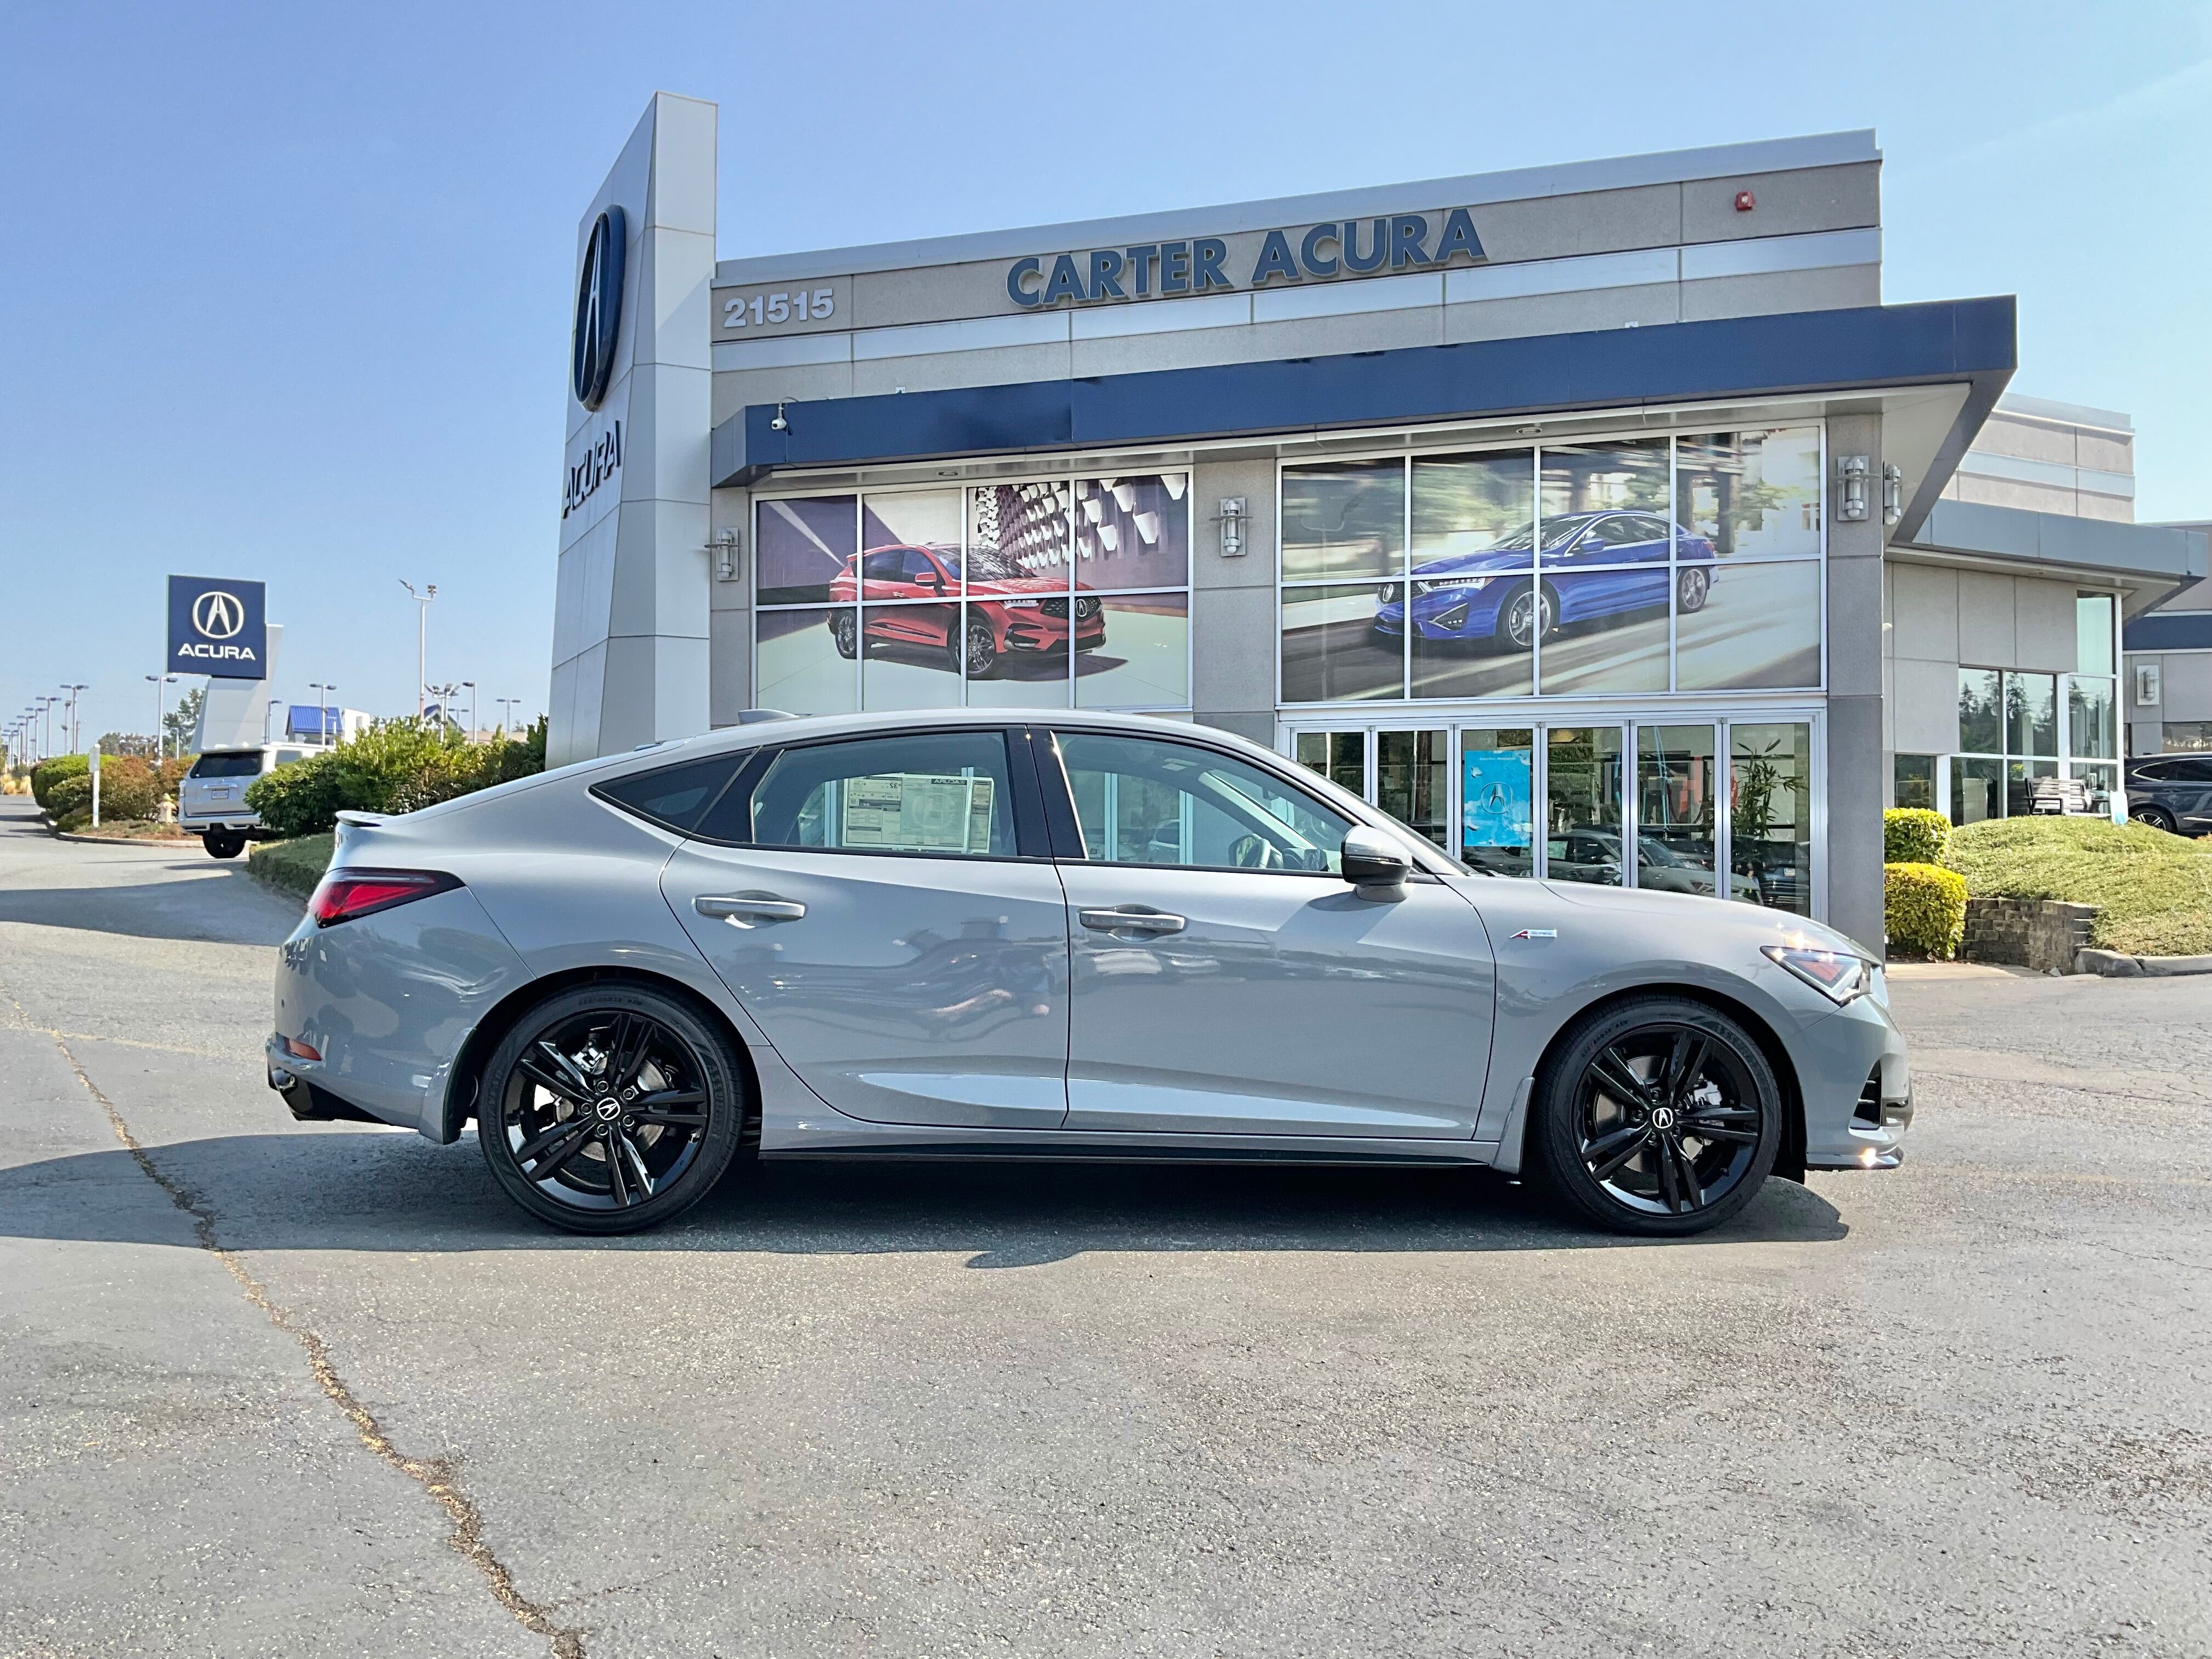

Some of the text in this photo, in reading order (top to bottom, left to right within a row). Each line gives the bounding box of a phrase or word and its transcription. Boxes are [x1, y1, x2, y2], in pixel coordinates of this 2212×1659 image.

[1006, 208, 1487, 308] CARTER ACURA
[724, 288, 834, 328] 21515
[562, 420, 620, 520] ACURA
[177, 642, 256, 661] ACURA
